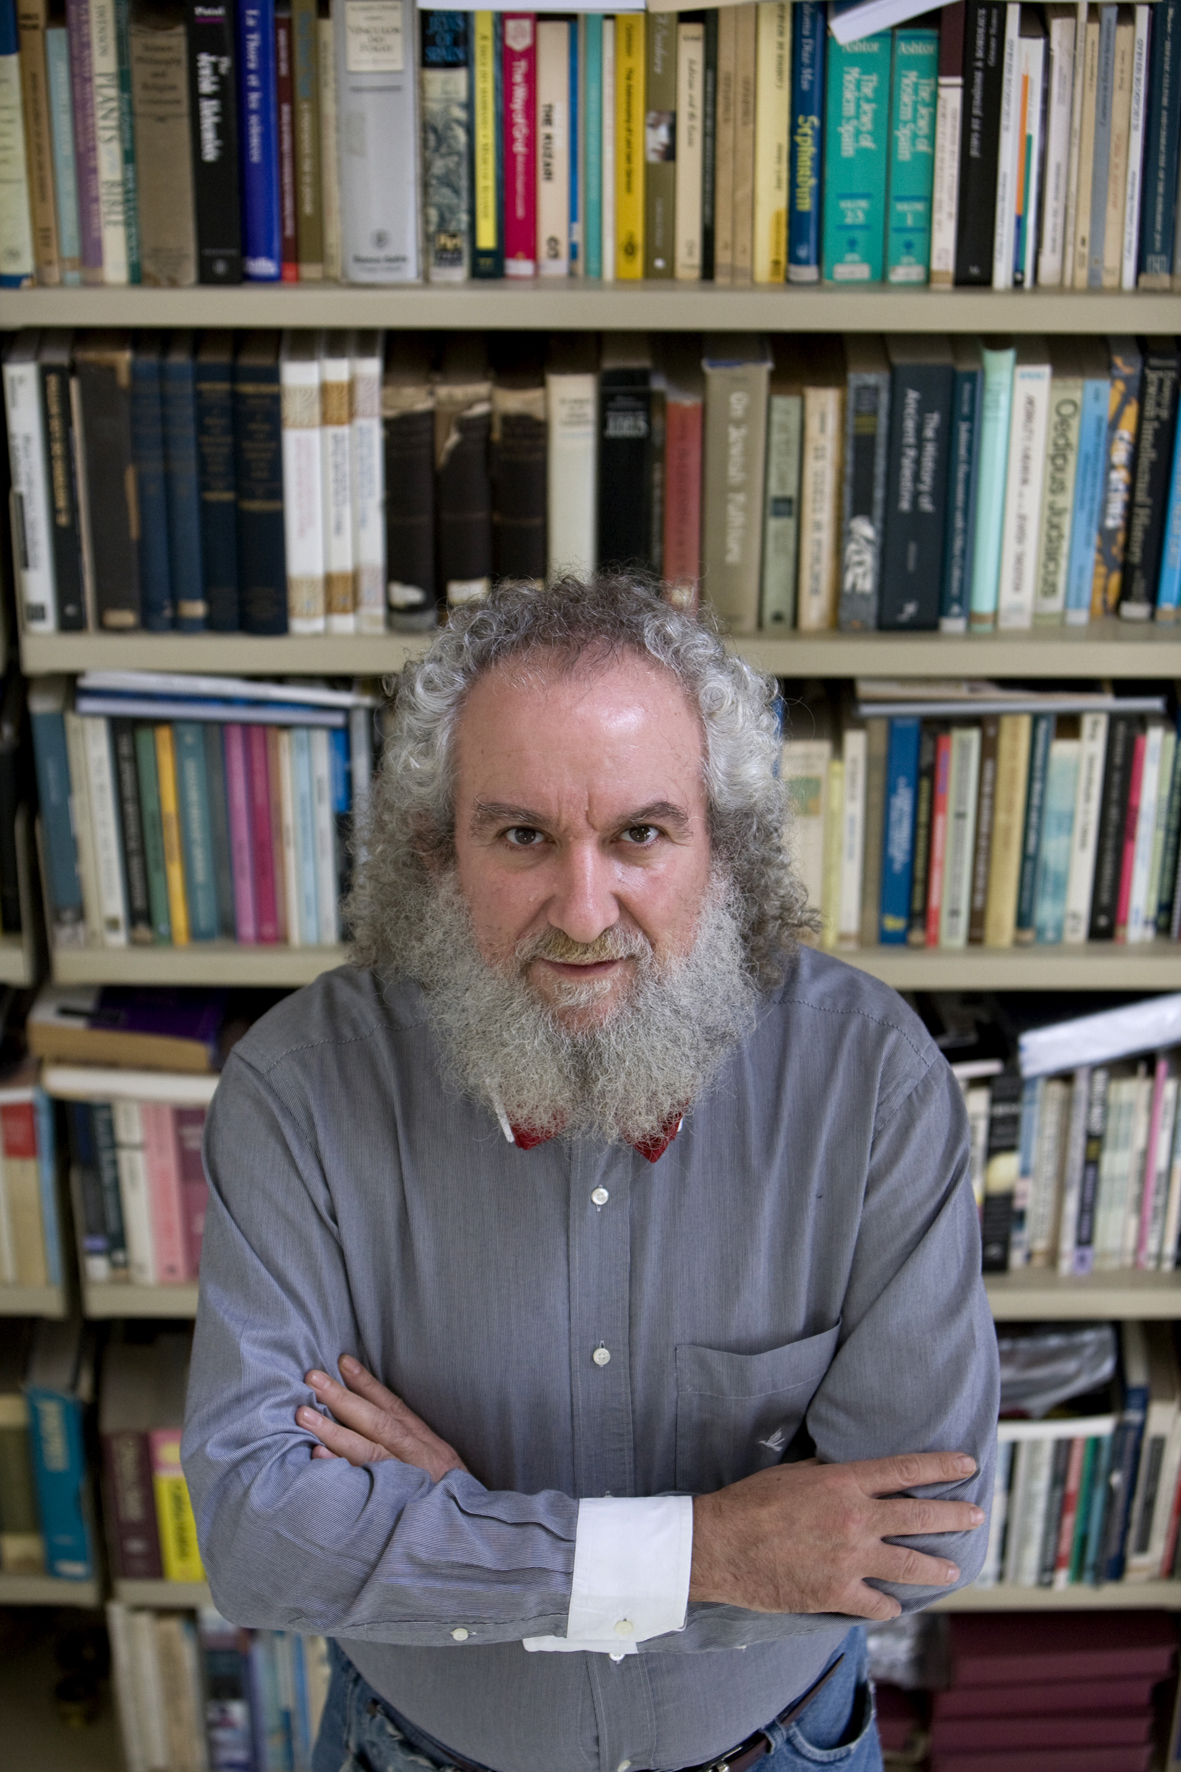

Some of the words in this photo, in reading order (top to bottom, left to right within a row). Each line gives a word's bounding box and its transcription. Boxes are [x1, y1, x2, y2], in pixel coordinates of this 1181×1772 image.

[511, 58, 529, 83] The
[898, 41, 936, 55] Ashtor
[97, 71, 119, 145] PLANTS
[843, 66, 861, 118] Moslem
[860, 73, 879, 100] The
[899, 70, 918, 121] Moslem
[917, 77, 937, 103] The
[541, 103, 554, 127] THE
[858, 100, 878, 132] Jews
[915, 104, 934, 137] Jews
[541, 133, 554, 182] KUZARI
[837, 118, 858, 159] Spain
[858, 133, 878, 151] of
[895, 121, 917, 162] Spain
[794, 114, 820, 213] Sephardim
[102, 180, 123, 229] BIBLE
[902, 387, 921, 447] Ancient
[921, 410, 941, 440] The
[727, 423, 749, 487] Jewish
[915, 441, 938, 493] History
[1047, 397, 1080, 497] Oedipus
[897, 447, 919, 513] Palestine
[917, 493, 937, 513] of
[1041, 498, 1070, 601] Judaicus
